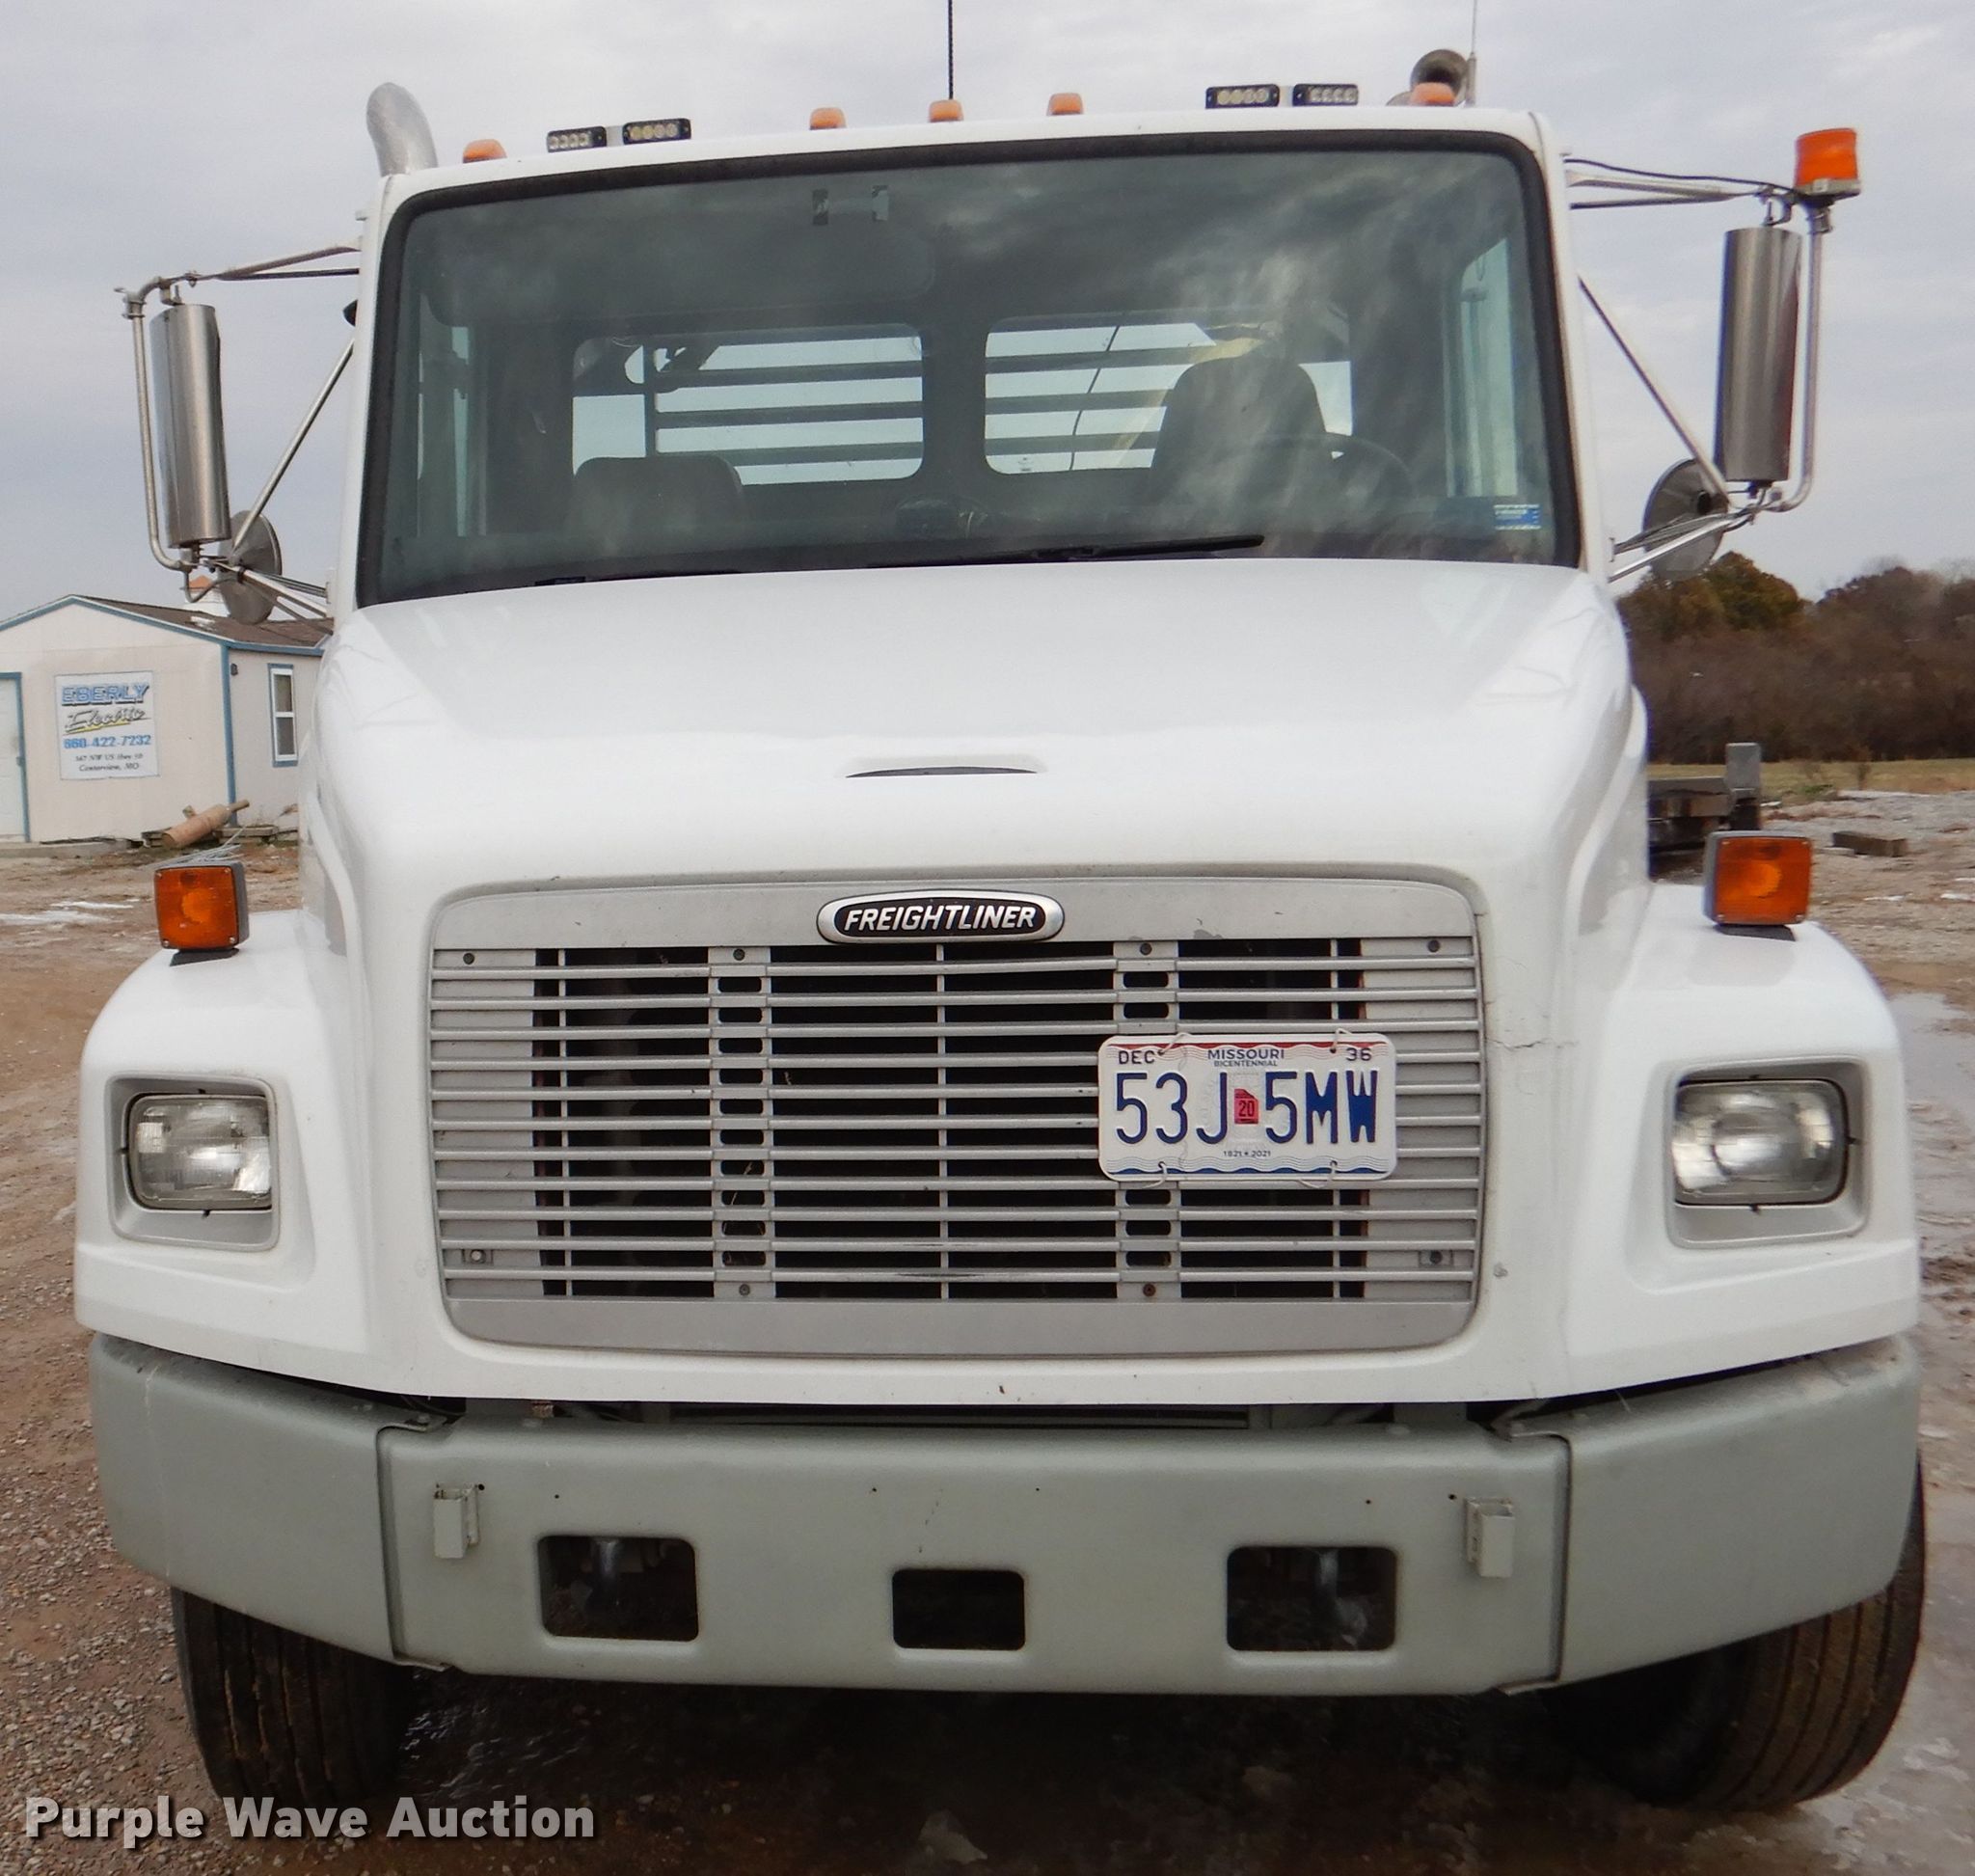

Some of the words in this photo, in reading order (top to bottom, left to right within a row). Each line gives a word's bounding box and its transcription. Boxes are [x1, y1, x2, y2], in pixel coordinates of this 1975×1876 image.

[62, 683, 149, 705] EBERLY
[65, 708, 148, 730] Electric
[844, 905, 1037, 932] FREIGHTLINER
[1118, 1049, 1155, 1065] DEC
[1206, 1048, 1285, 1061] MISSOURI
[1345, 1047, 1372, 1062] 36
[1213, 1059, 1279, 1068] BICENTENNIAL
[1238, 1100, 1255, 1117] 20
